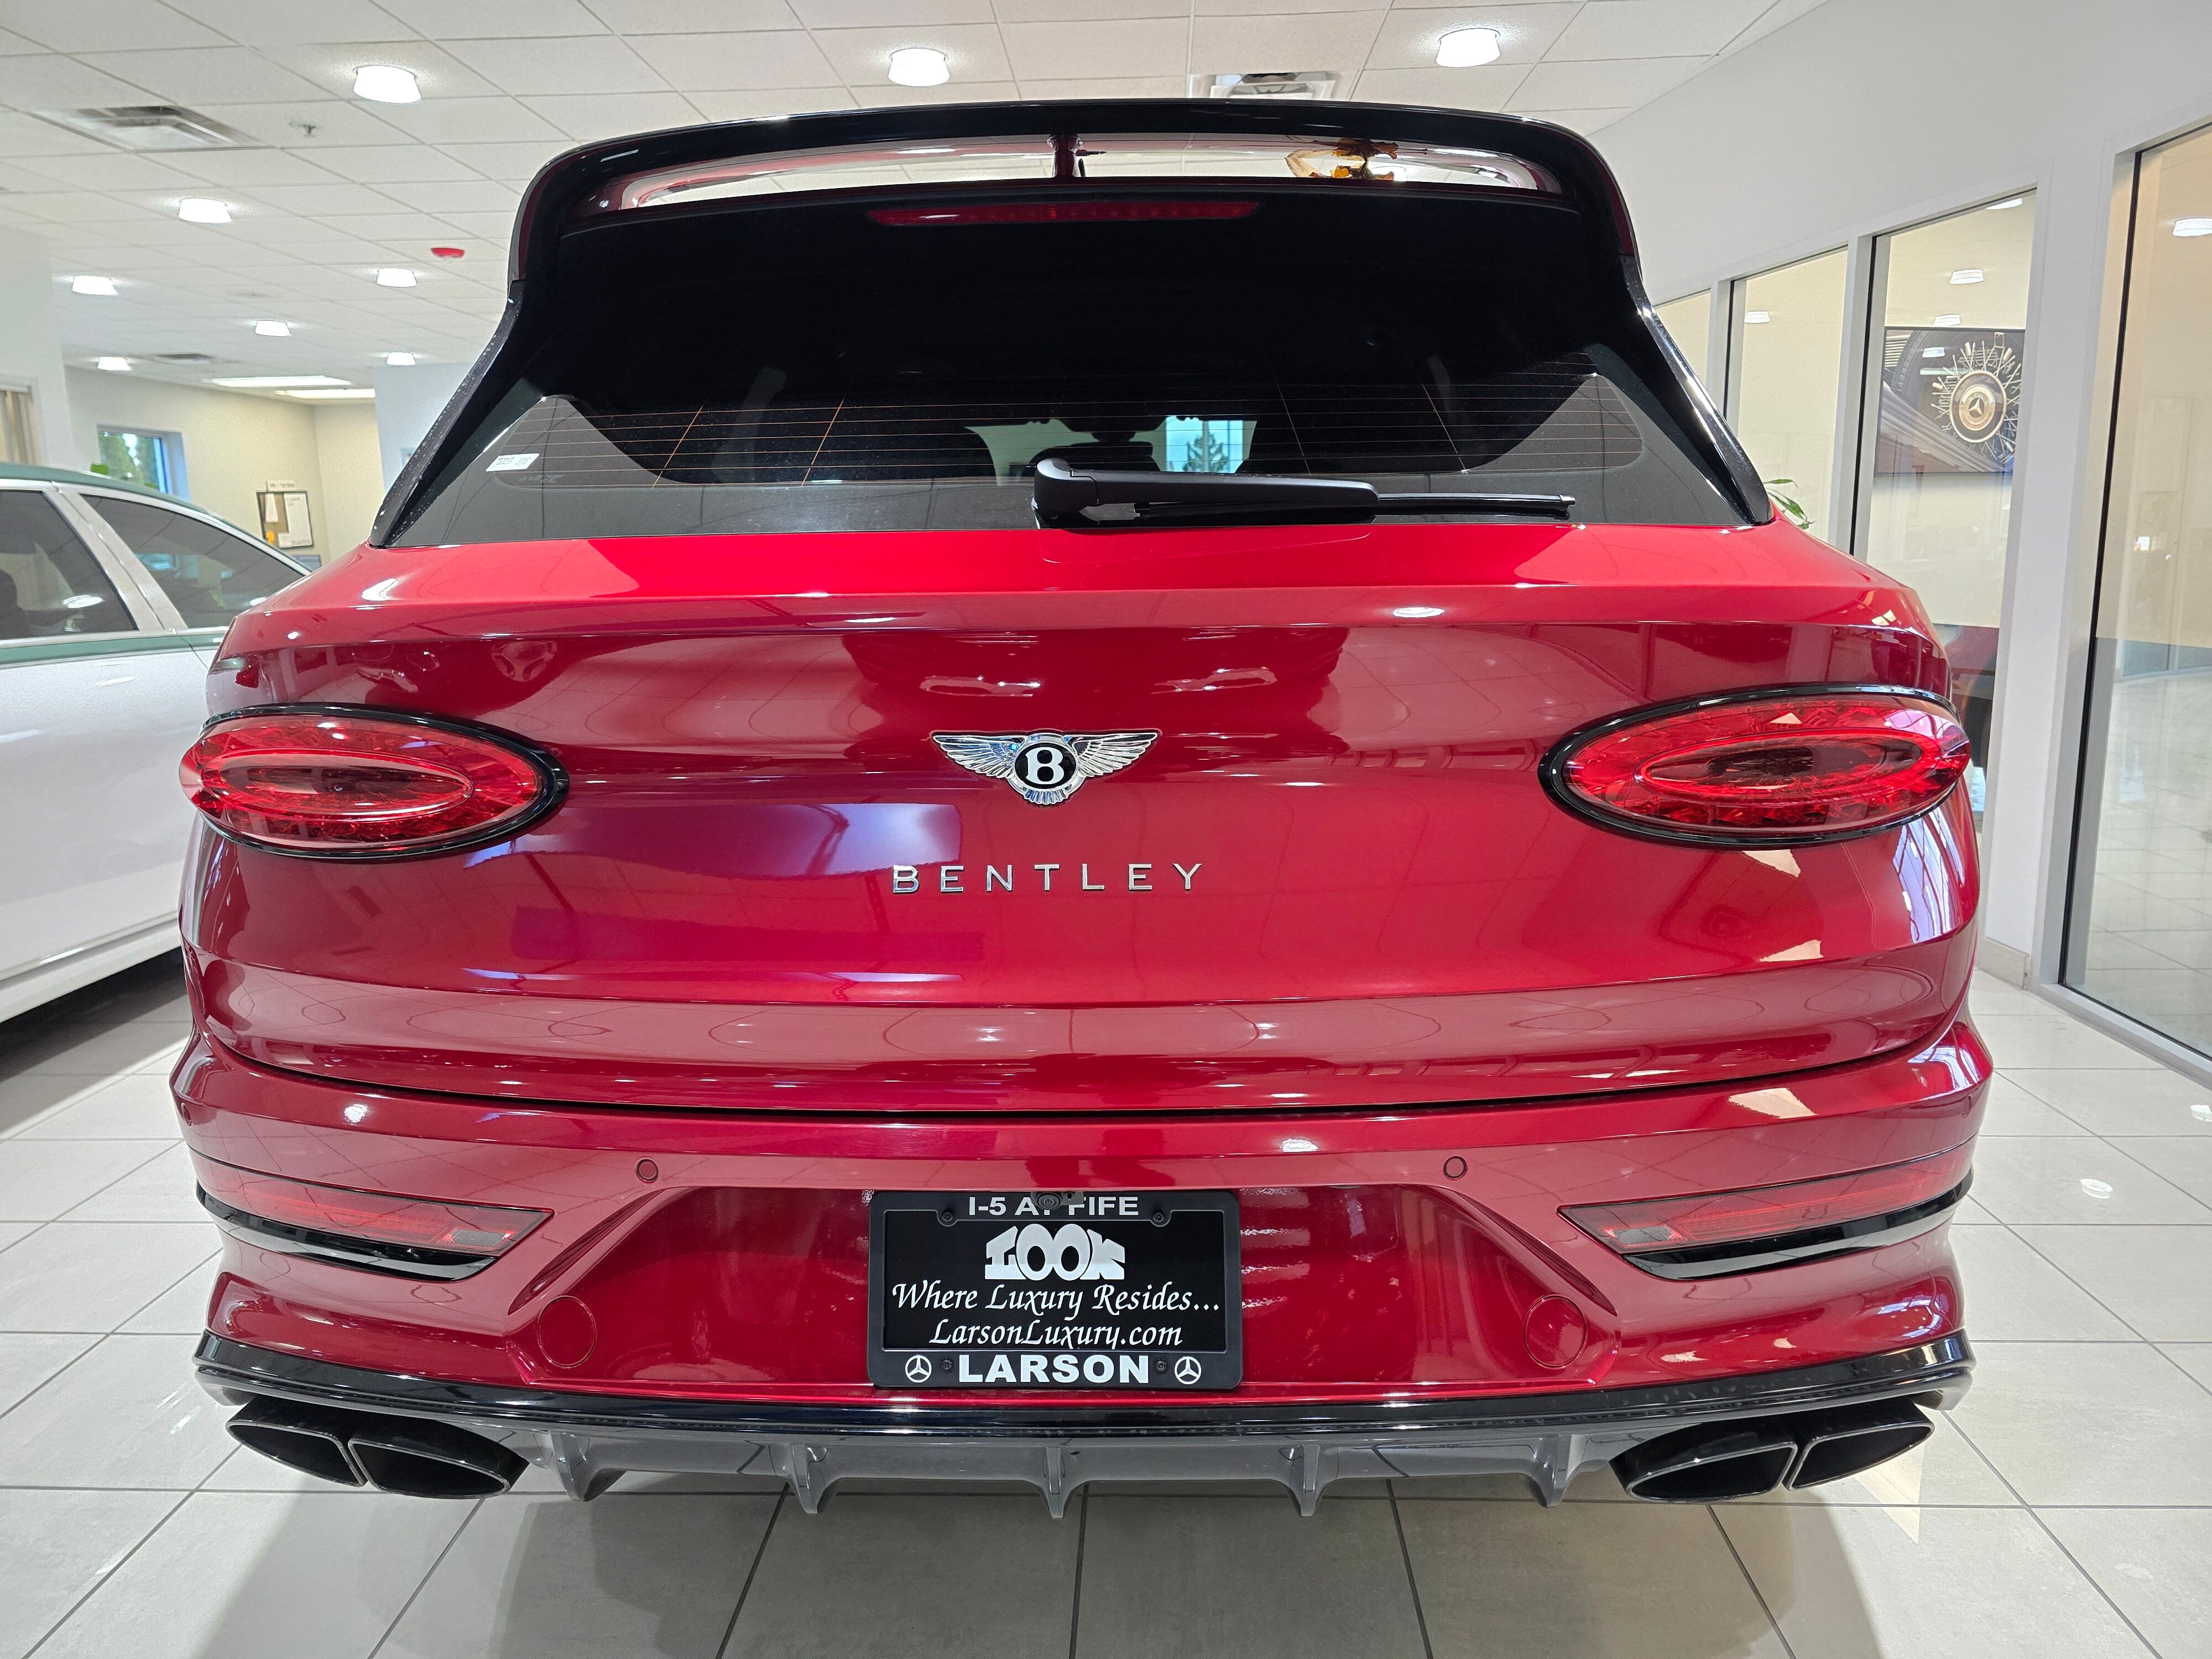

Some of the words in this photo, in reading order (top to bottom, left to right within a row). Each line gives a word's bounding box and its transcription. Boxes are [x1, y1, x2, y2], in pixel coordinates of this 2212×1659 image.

[1025, 747, 1065, 785] B
[892, 863, 1202, 893] BENTLEY
[969, 1197, 1006, 1215] I-5
[1014, 1197, 1050, 1215] A
[892, 1279, 978, 1309] Where
[984, 1284, 1083, 1321] Luxury
[1092, 1282, 1219, 1315] Resides...
[928, 1319, 1183, 1349] LarsonLuxury.com
[959, 1354, 1149, 1384] LARSON
